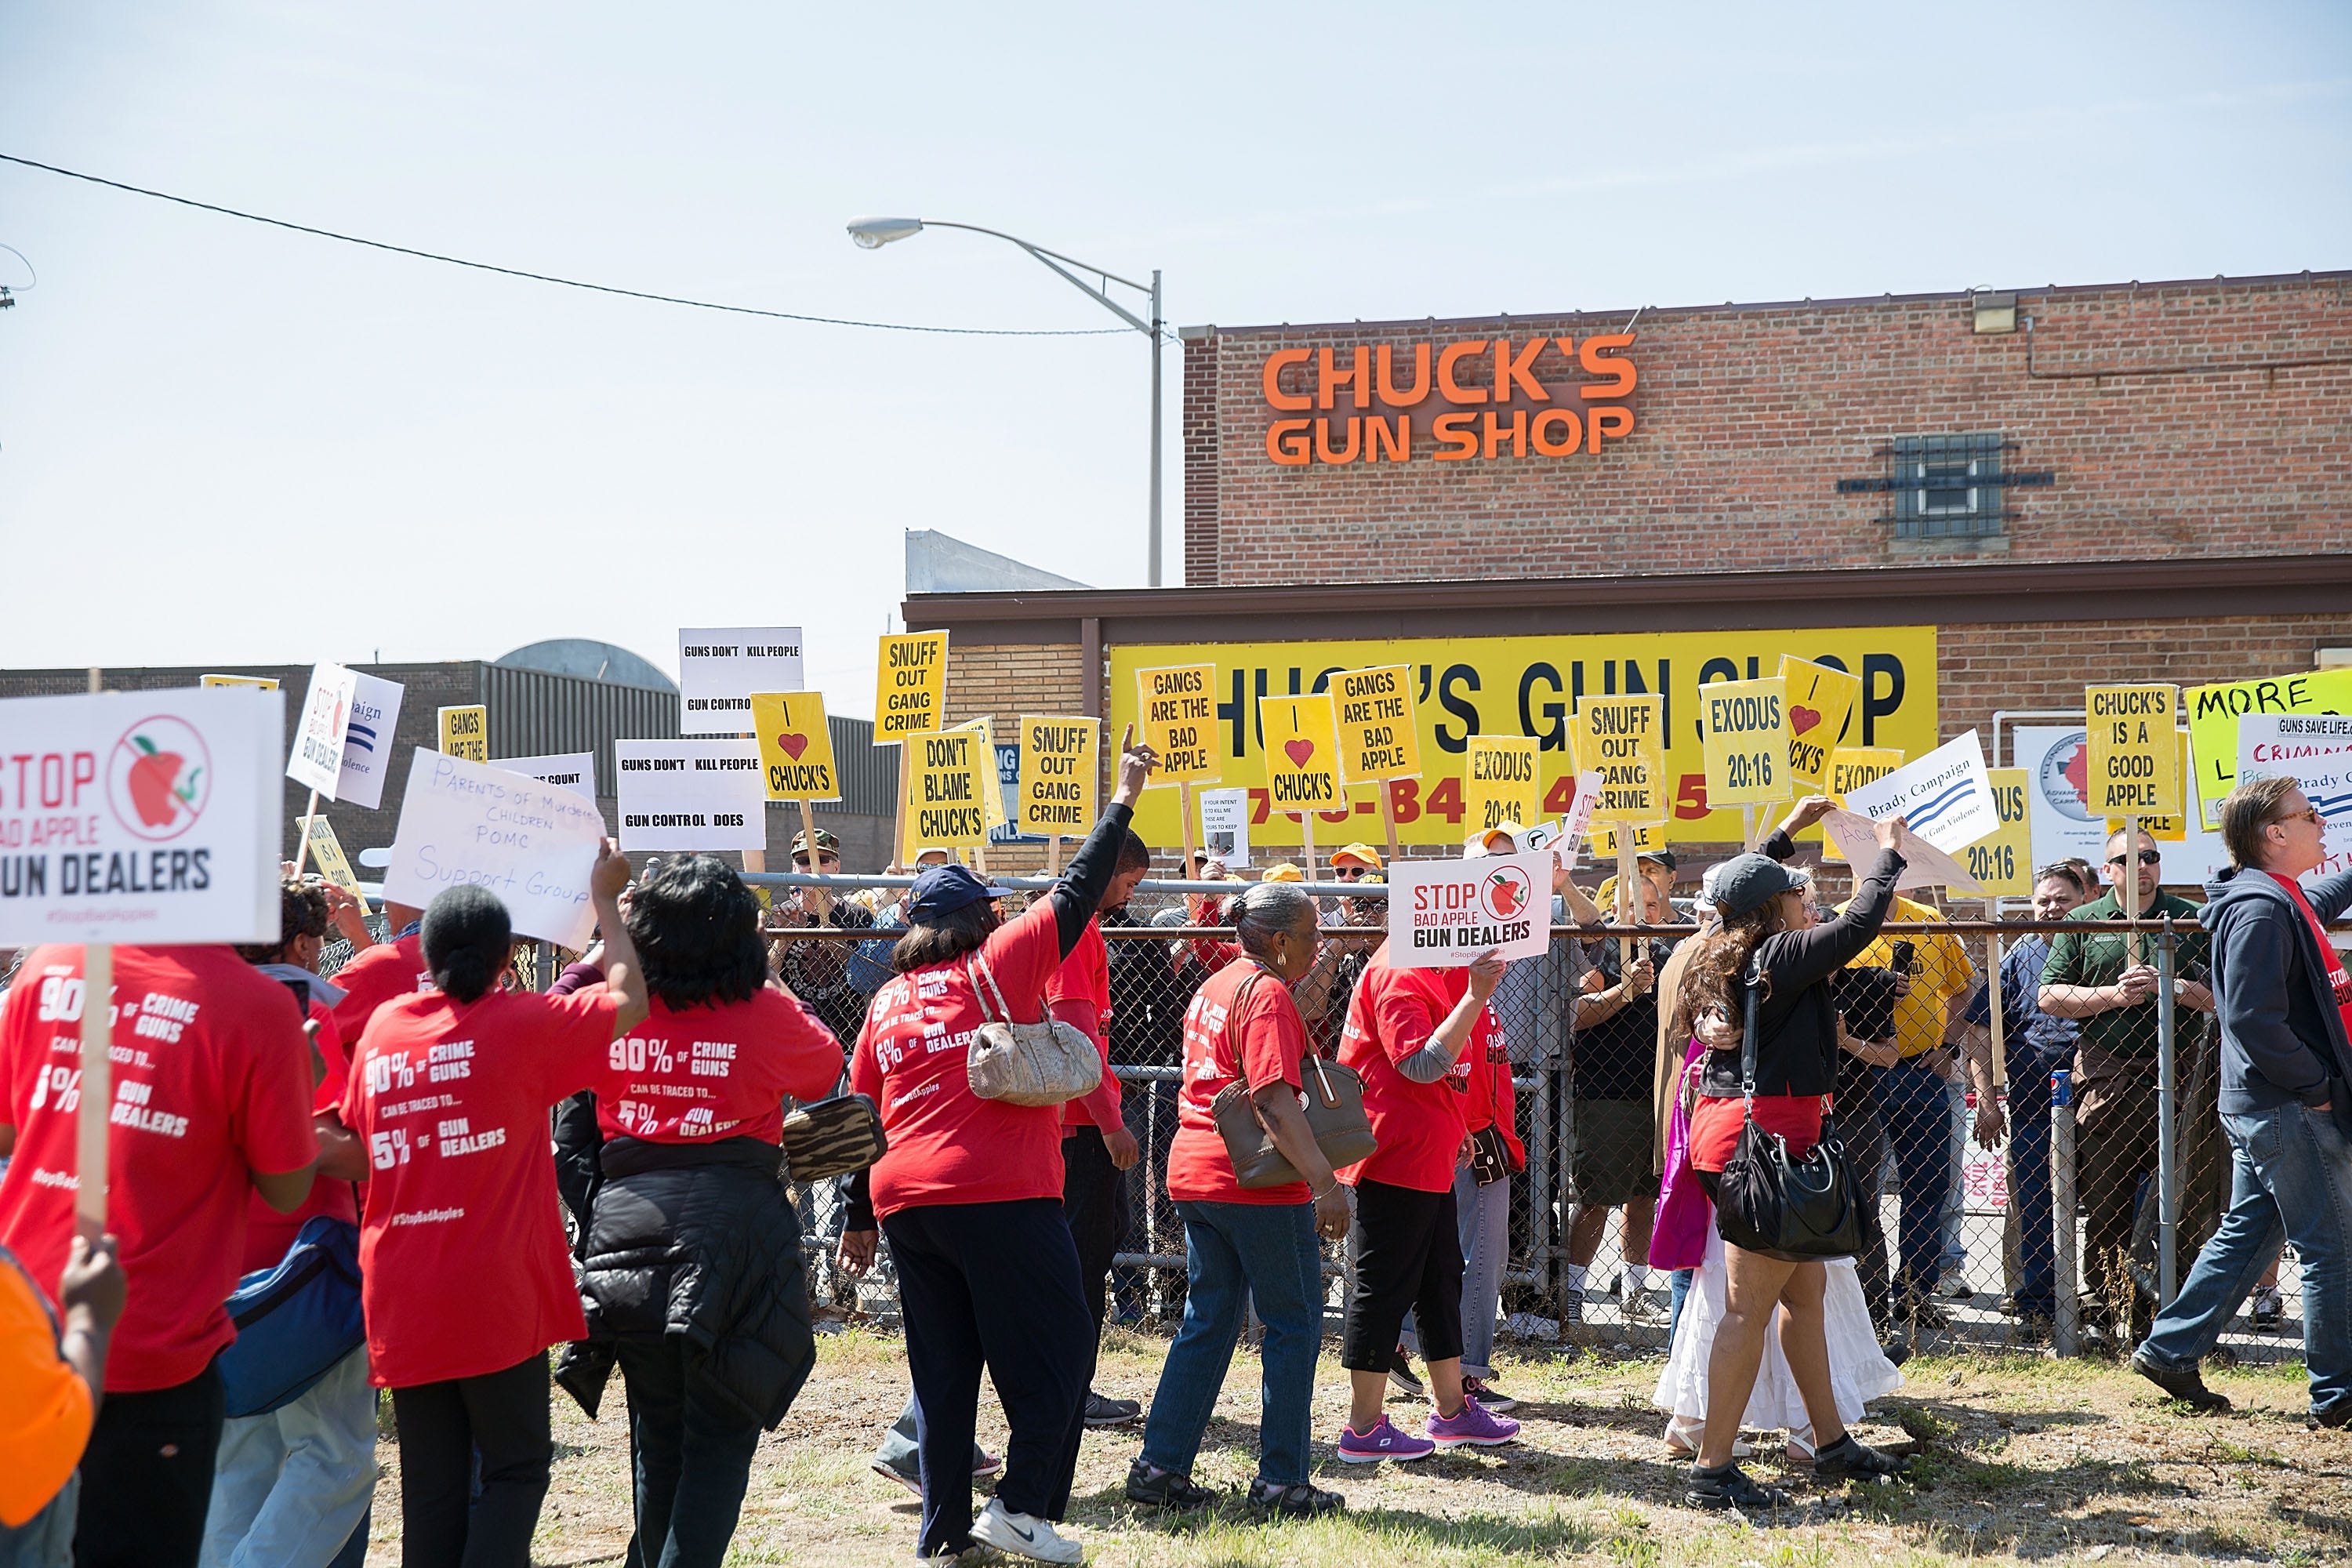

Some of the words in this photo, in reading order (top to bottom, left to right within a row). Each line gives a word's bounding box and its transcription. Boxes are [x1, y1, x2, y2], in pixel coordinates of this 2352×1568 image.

[1262, 332, 1639, 412] CHUCK'S
[1265, 415, 1410, 466] GUN
[1432, 406, 1636, 463] SHOP
[684, 646, 710, 657] GUNS
[712, 645, 739, 657] DON'T
[746, 645, 766, 657] KILL
[767, 645, 799, 657] PEOPLE
[889, 641, 938, 668] SNUFF
[895, 670, 927, 687] OUT
[1153, 670, 1202, 695] GANGS
[1345, 672, 1396, 697] GANGS
[1807, 674, 1819, 701] I
[688, 699, 709, 710] GUN
[710, 698, 750, 710] CONTRO
[887, 691, 931, 710] GANG
[1150, 701, 1177, 722] ARE
[1181, 697, 1210, 719] THE
[1344, 702, 1371, 724] ARE
[1374, 698, 1404, 719] THE
[2094, 691, 2165, 717] CHUCK'S
[2197, 678, 2312, 720] MORE
[451, 711, 479, 736] GANGS
[783, 701, 790, 728] I
[884, 712, 931, 731] CRIME
[1292, 706, 1298, 732] I
[1591, 706, 1650, 735] SNUFF
[1711, 695, 1780, 733] EXODUS
[2280, 719, 2303, 733] GUNS
[2305, 720, 2327, 734] SAVE
[1032, 726, 1087, 753] SNUFF
[1169, 727, 1197, 749] BAD
[1363, 726, 1393, 748] BAD
[2113, 721, 2127, 744] IS
[2137, 721, 2148, 744] A
[448, 740, 465, 758] ARE
[466, 739, 483, 761] THE
[926, 738, 967, 768] DON'T
[1164, 749, 1207, 773] APPLE
[1361, 746, 1406, 771] APPLE
[1601, 739, 1640, 758] OUT
[341, 756, 370, 774] iolence
[621, 759, 652, 771] GUNS
[654, 759, 685, 771] DON'T
[695, 758, 717, 771] KILL
[720, 758, 758, 771] PEOPLE
[1040, 757, 1076, 775] OUT
[1474, 750, 1532, 782] EXODUS
[1595, 765, 1646, 785] GANG
[1727, 752, 1772, 788] 20:16
[2107, 755, 2154, 779] GOOD
[0, 750, 96, 810] TOP
[548, 773, 580, 785] COUNT
[770, 764, 829, 791] CHUCK'S
[924, 772, 972, 802] BLAME
[1274, 773, 1332, 801] CHUCK'S
[1834, 764, 1896, 795] EXOD
[1867, 792, 1907, 818] Brady
[1911, 759, 1971, 797] Campaign
[514, 792, 532, 805] OF
[1032, 782, 1080, 800] GANG
[1594, 789, 1650, 811] CRIME
[2106, 784, 2156, 807] APPLE
[486, 806, 554, 830] CHILDREN
[625, 814, 650, 827] GUN
[652, 814, 706, 827] CONTROL
[713, 814, 744, 826] DOES
[920, 808, 982, 838] CHUCK'S
[1029, 804, 1082, 823] CRIME
[1928, 826, 1947, 843] Gun
[1947, 803, 1981, 829] Violence
[29, 815, 100, 847] APPLE
[476, 825, 528, 848] POMC
[1, 853, 47, 898] UN
[61, 848, 211, 897] DEALERS
[415, 844, 517, 891] Support
[526, 871, 590, 904] Group
[1967, 845, 2014, 882] 20:16
[1414, 883, 1475, 910] STOP
[1414, 913, 1437, 927] BAD
[1441, 911, 1478, 926] APPLE
[1414, 927, 1451, 948] GUN
[1457, 920, 1530, 947] DEALERS
[918, 980, 949, 1000] GUNS
[123, 1002, 140, 1018] OF
[142, 992, 200, 1025] CRIME
[891, 1015, 899, 1026] BE
[900, 1008, 924, 1024] TRACED
[135, 1014, 184, 1044] GUNS
[926, 1029, 978, 1054] DEALERS
[51, 1036, 77, 1053] CAN
[609, 1037, 673, 1073] 90%
[677, 1051, 689, 1063] OF
[691, 1041, 738, 1060] CRIME
[876, 1035, 903, 1074] 5%
[908, 1037, 918, 1049] OF
[923, 1021, 946, 1039] GUN
[365, 1050, 414, 1098] 90%
[416, 1059, 427, 1073] OF
[429, 1040, 475, 1062] CRIME
[430, 1060, 470, 1083] GUNS
[691, 1059, 730, 1077] GUNS
[118, 1080, 153, 1106] GUN
[630, 1083, 649, 1094] CAN
[650, 1084, 661, 1095] BE
[662, 1084, 695, 1098] TRACED
[110, 1101, 190, 1138] DEALERS
[381, 1103, 398, 1120] CAN
[398, 1102, 408, 1115] BE
[408, 1096, 438, 1113] TRACED
[684, 1107, 714, 1124] GUN
[371, 1127, 410, 1171] 5%
[417, 1134, 430, 1149] OF
[437, 1117, 470, 1138] GUN
[439, 1127, 506, 1158] DEALERS
[392, 1207, 465, 1227] #StopBadApples
